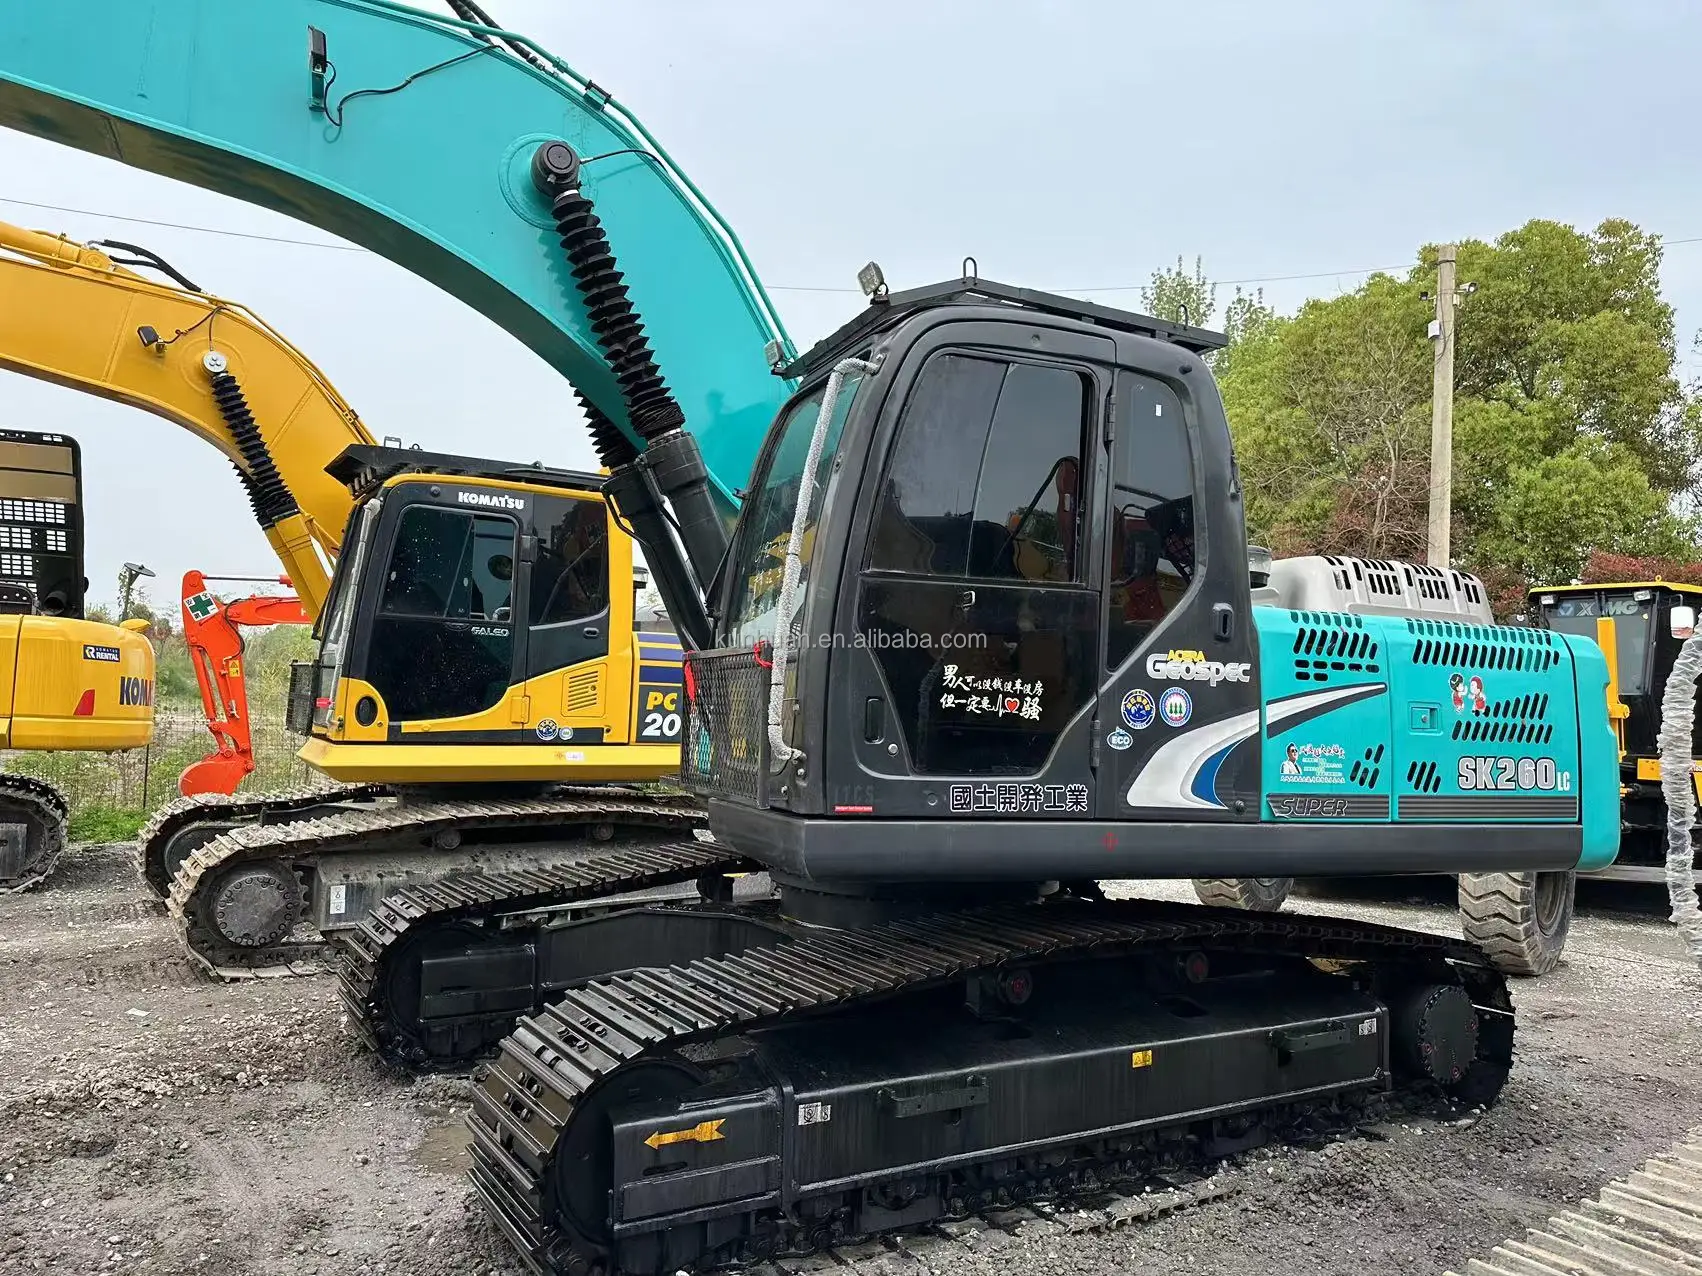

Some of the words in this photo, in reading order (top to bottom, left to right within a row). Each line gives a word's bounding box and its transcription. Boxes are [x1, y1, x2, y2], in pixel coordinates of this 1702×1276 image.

[458, 491, 525, 510] KOMATSU
[1576, 600, 1639, 617] XMG
[471, 626, 510, 637] GALEO
[96, 652, 119, 661] RENTAL
[1146, 653, 1251, 687] Geospec
[646, 691, 678, 711] PC
[1111, 735, 1130, 744] ECO
[1458, 755, 1556, 790] SK260
[1557, 771, 1571, 791] LC
[1280, 798, 1348, 816] SUPER
